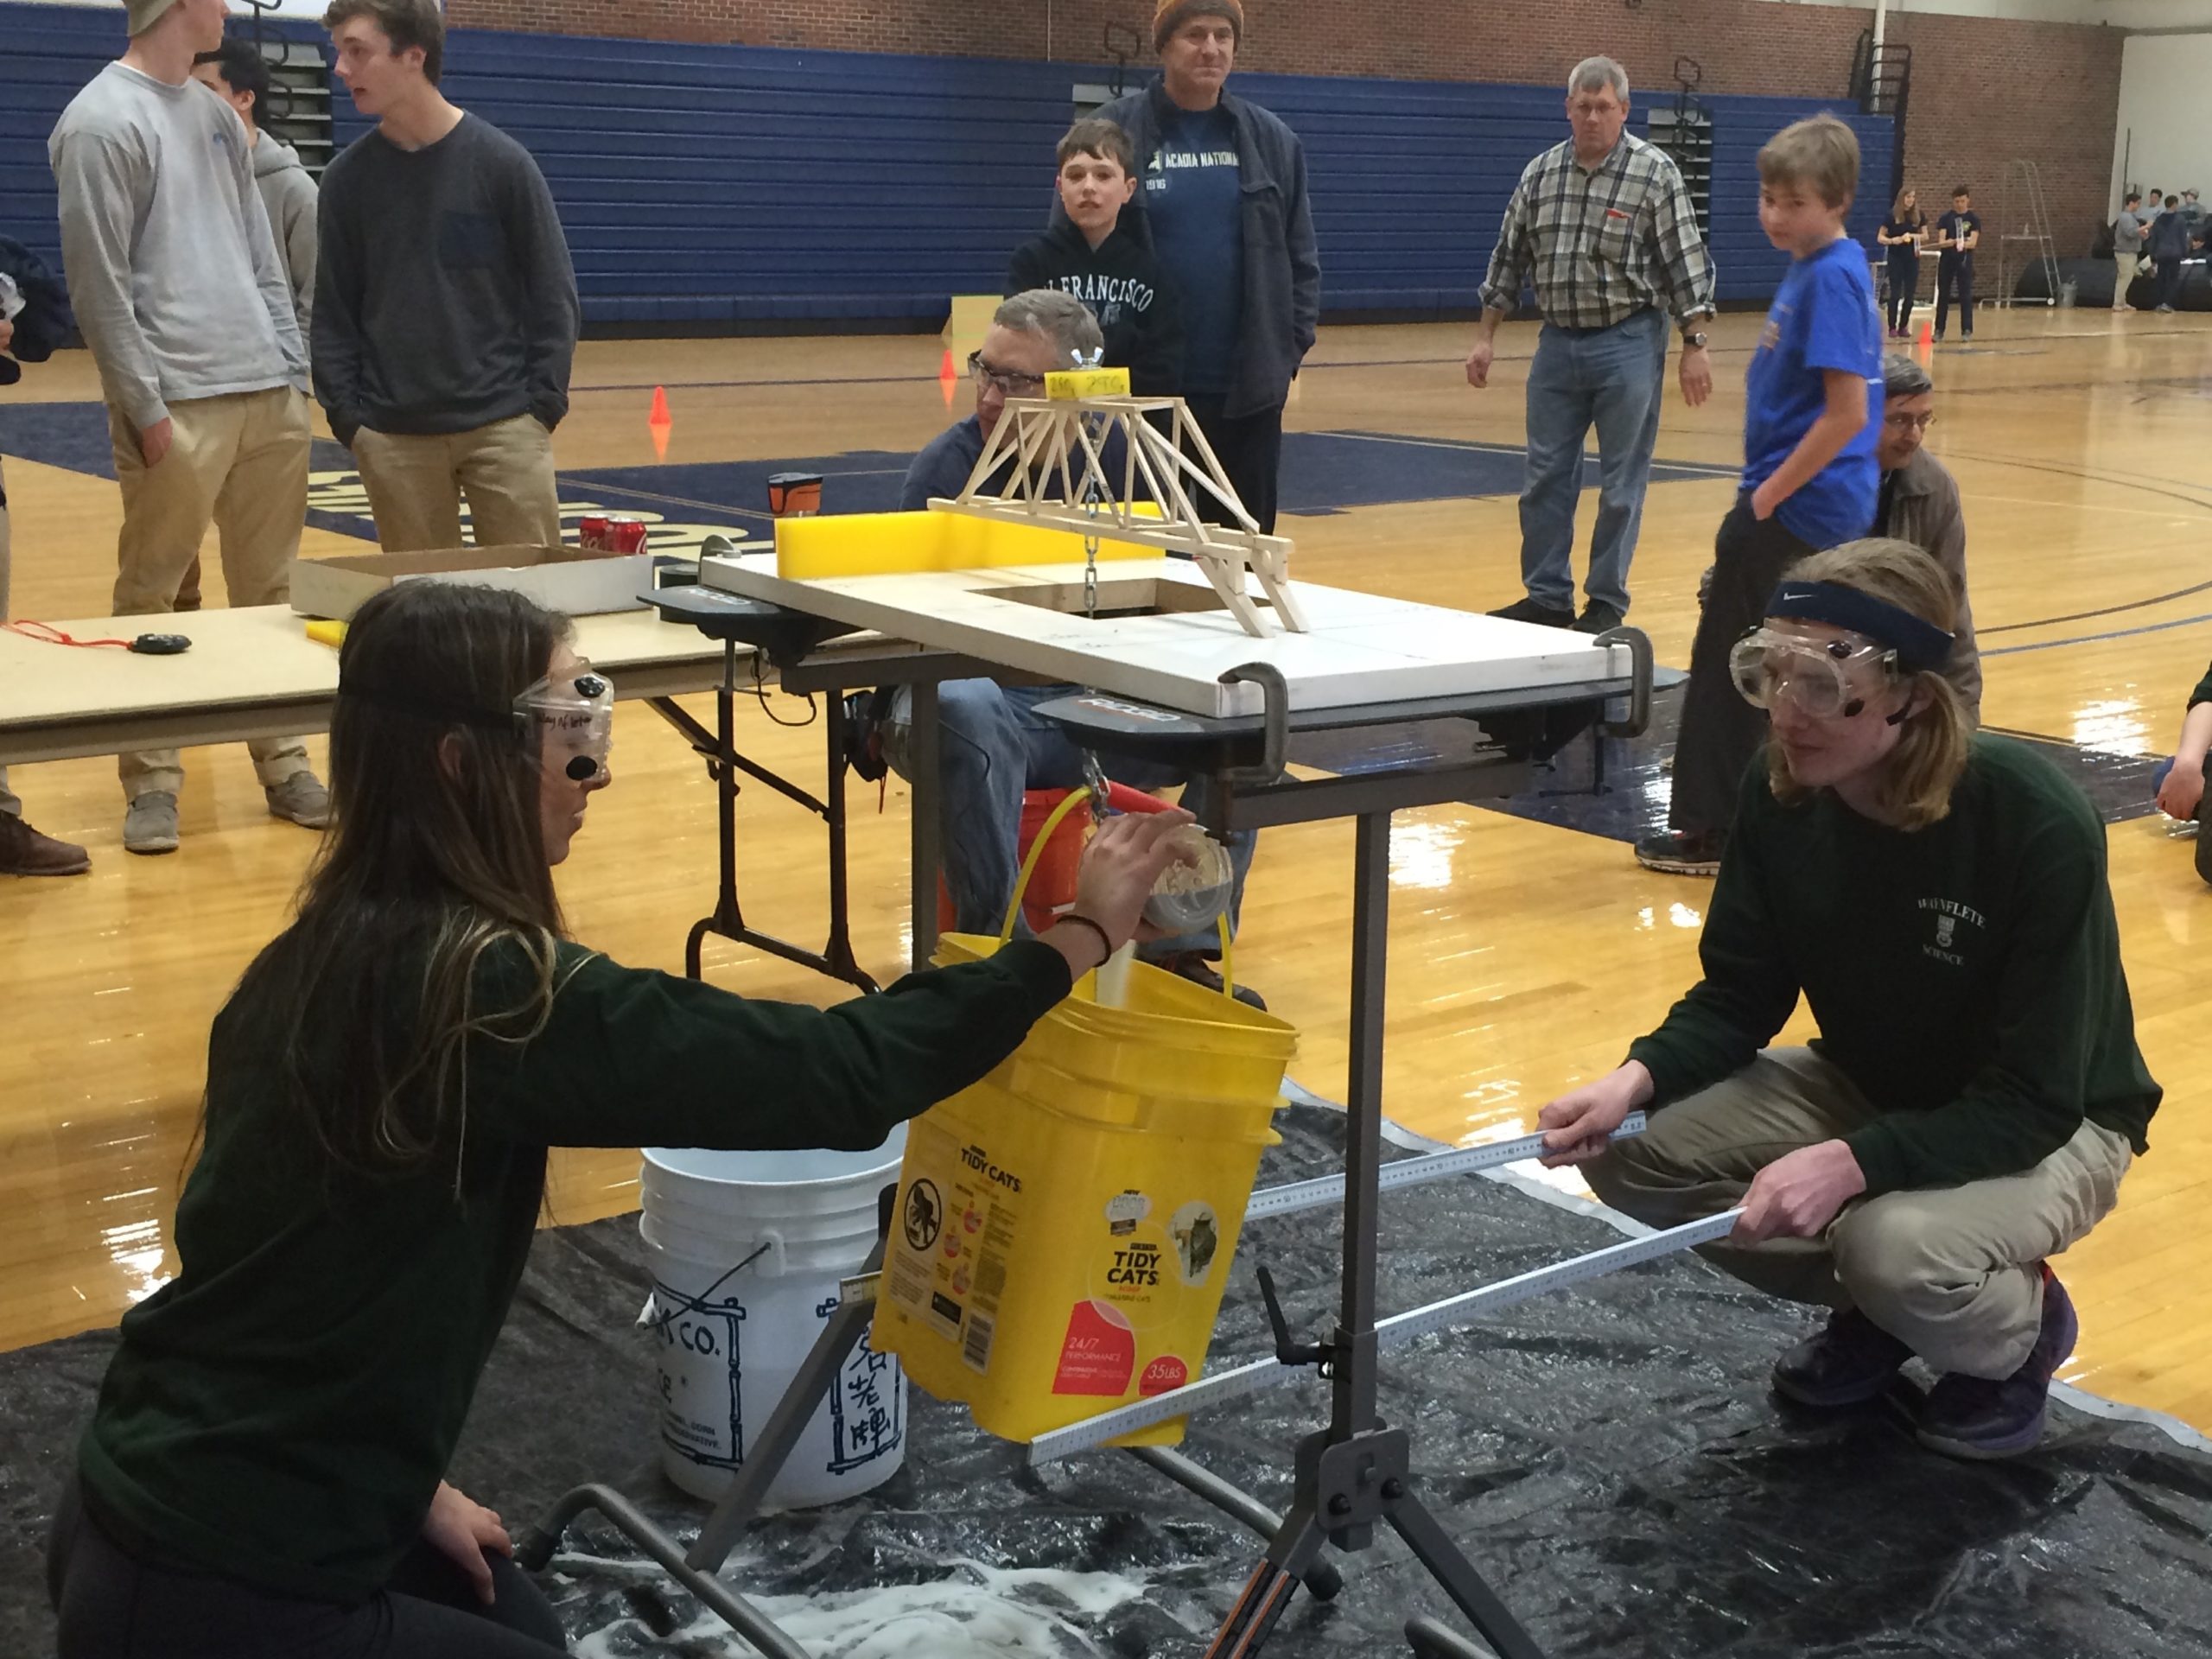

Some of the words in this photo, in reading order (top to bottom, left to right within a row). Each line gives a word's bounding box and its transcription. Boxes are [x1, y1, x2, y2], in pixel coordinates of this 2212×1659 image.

[1165, 153, 1199, 168] ACADIA
[1145, 178, 1166, 191] 1916
[1060, 273, 1154, 313] FRANCISCO
[961, 1147, 989, 1175] TIDY
[988, 1166, 1021, 1193] CATS
[1114, 1251, 1161, 1269] TIDY
[1107, 1268, 1159, 1286] CATS
[680, 1321, 721, 1357] CO.
[1068, 1337, 1100, 1350] 24/7
